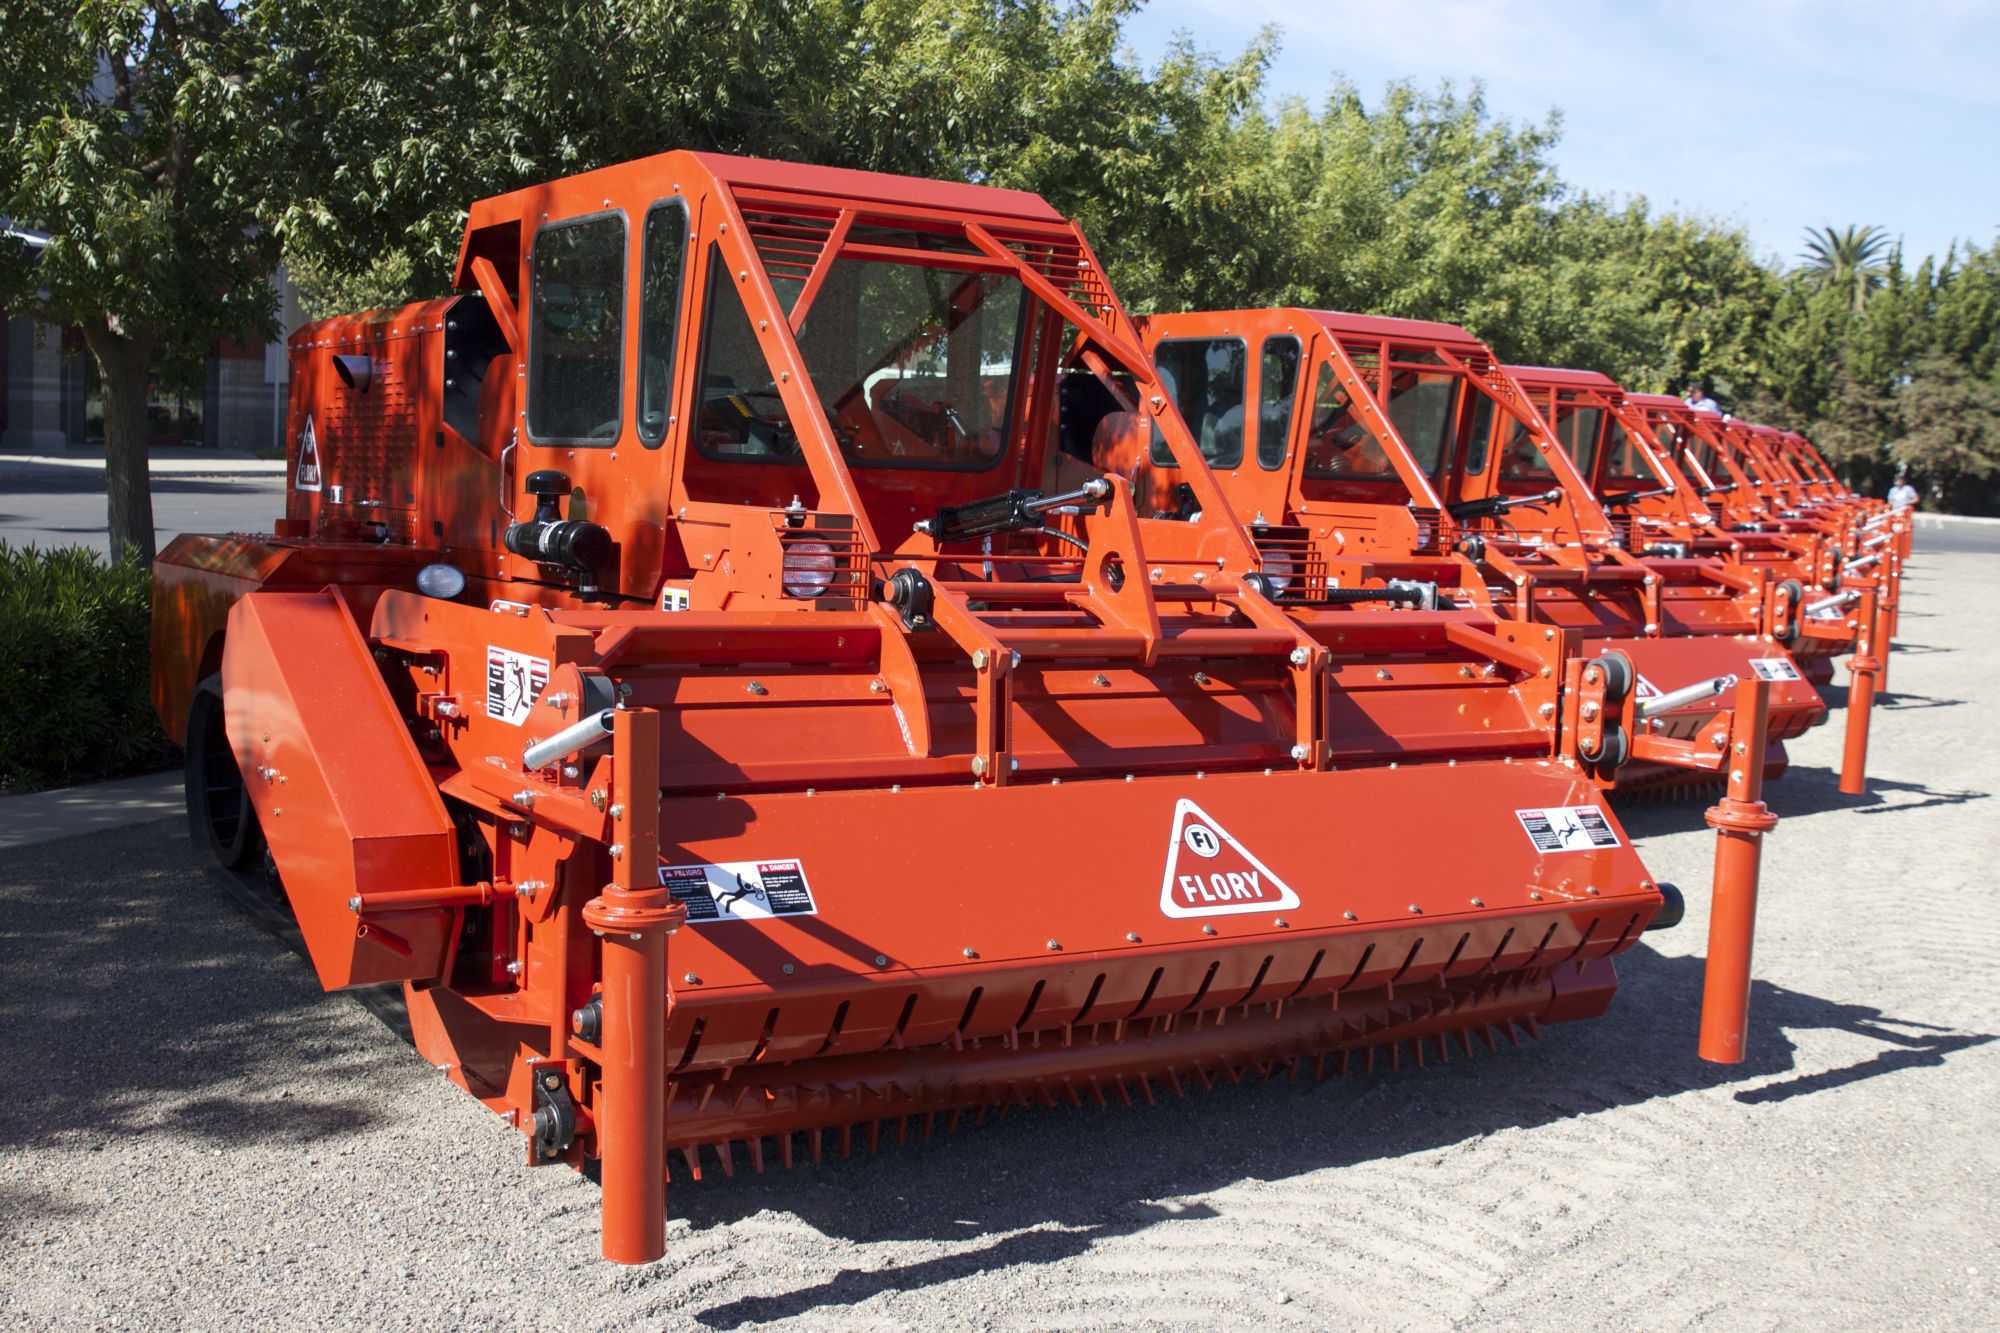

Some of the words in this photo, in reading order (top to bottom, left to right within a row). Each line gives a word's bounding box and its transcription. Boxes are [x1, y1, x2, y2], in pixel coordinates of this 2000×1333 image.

[300, 464, 317, 482] FLORY
[1191, 831, 1214, 849] FI
[673, 869, 702, 877] PELIGRO
[769, 863, 796, 871] DANGER
[1179, 871, 1263, 903] FLORY
